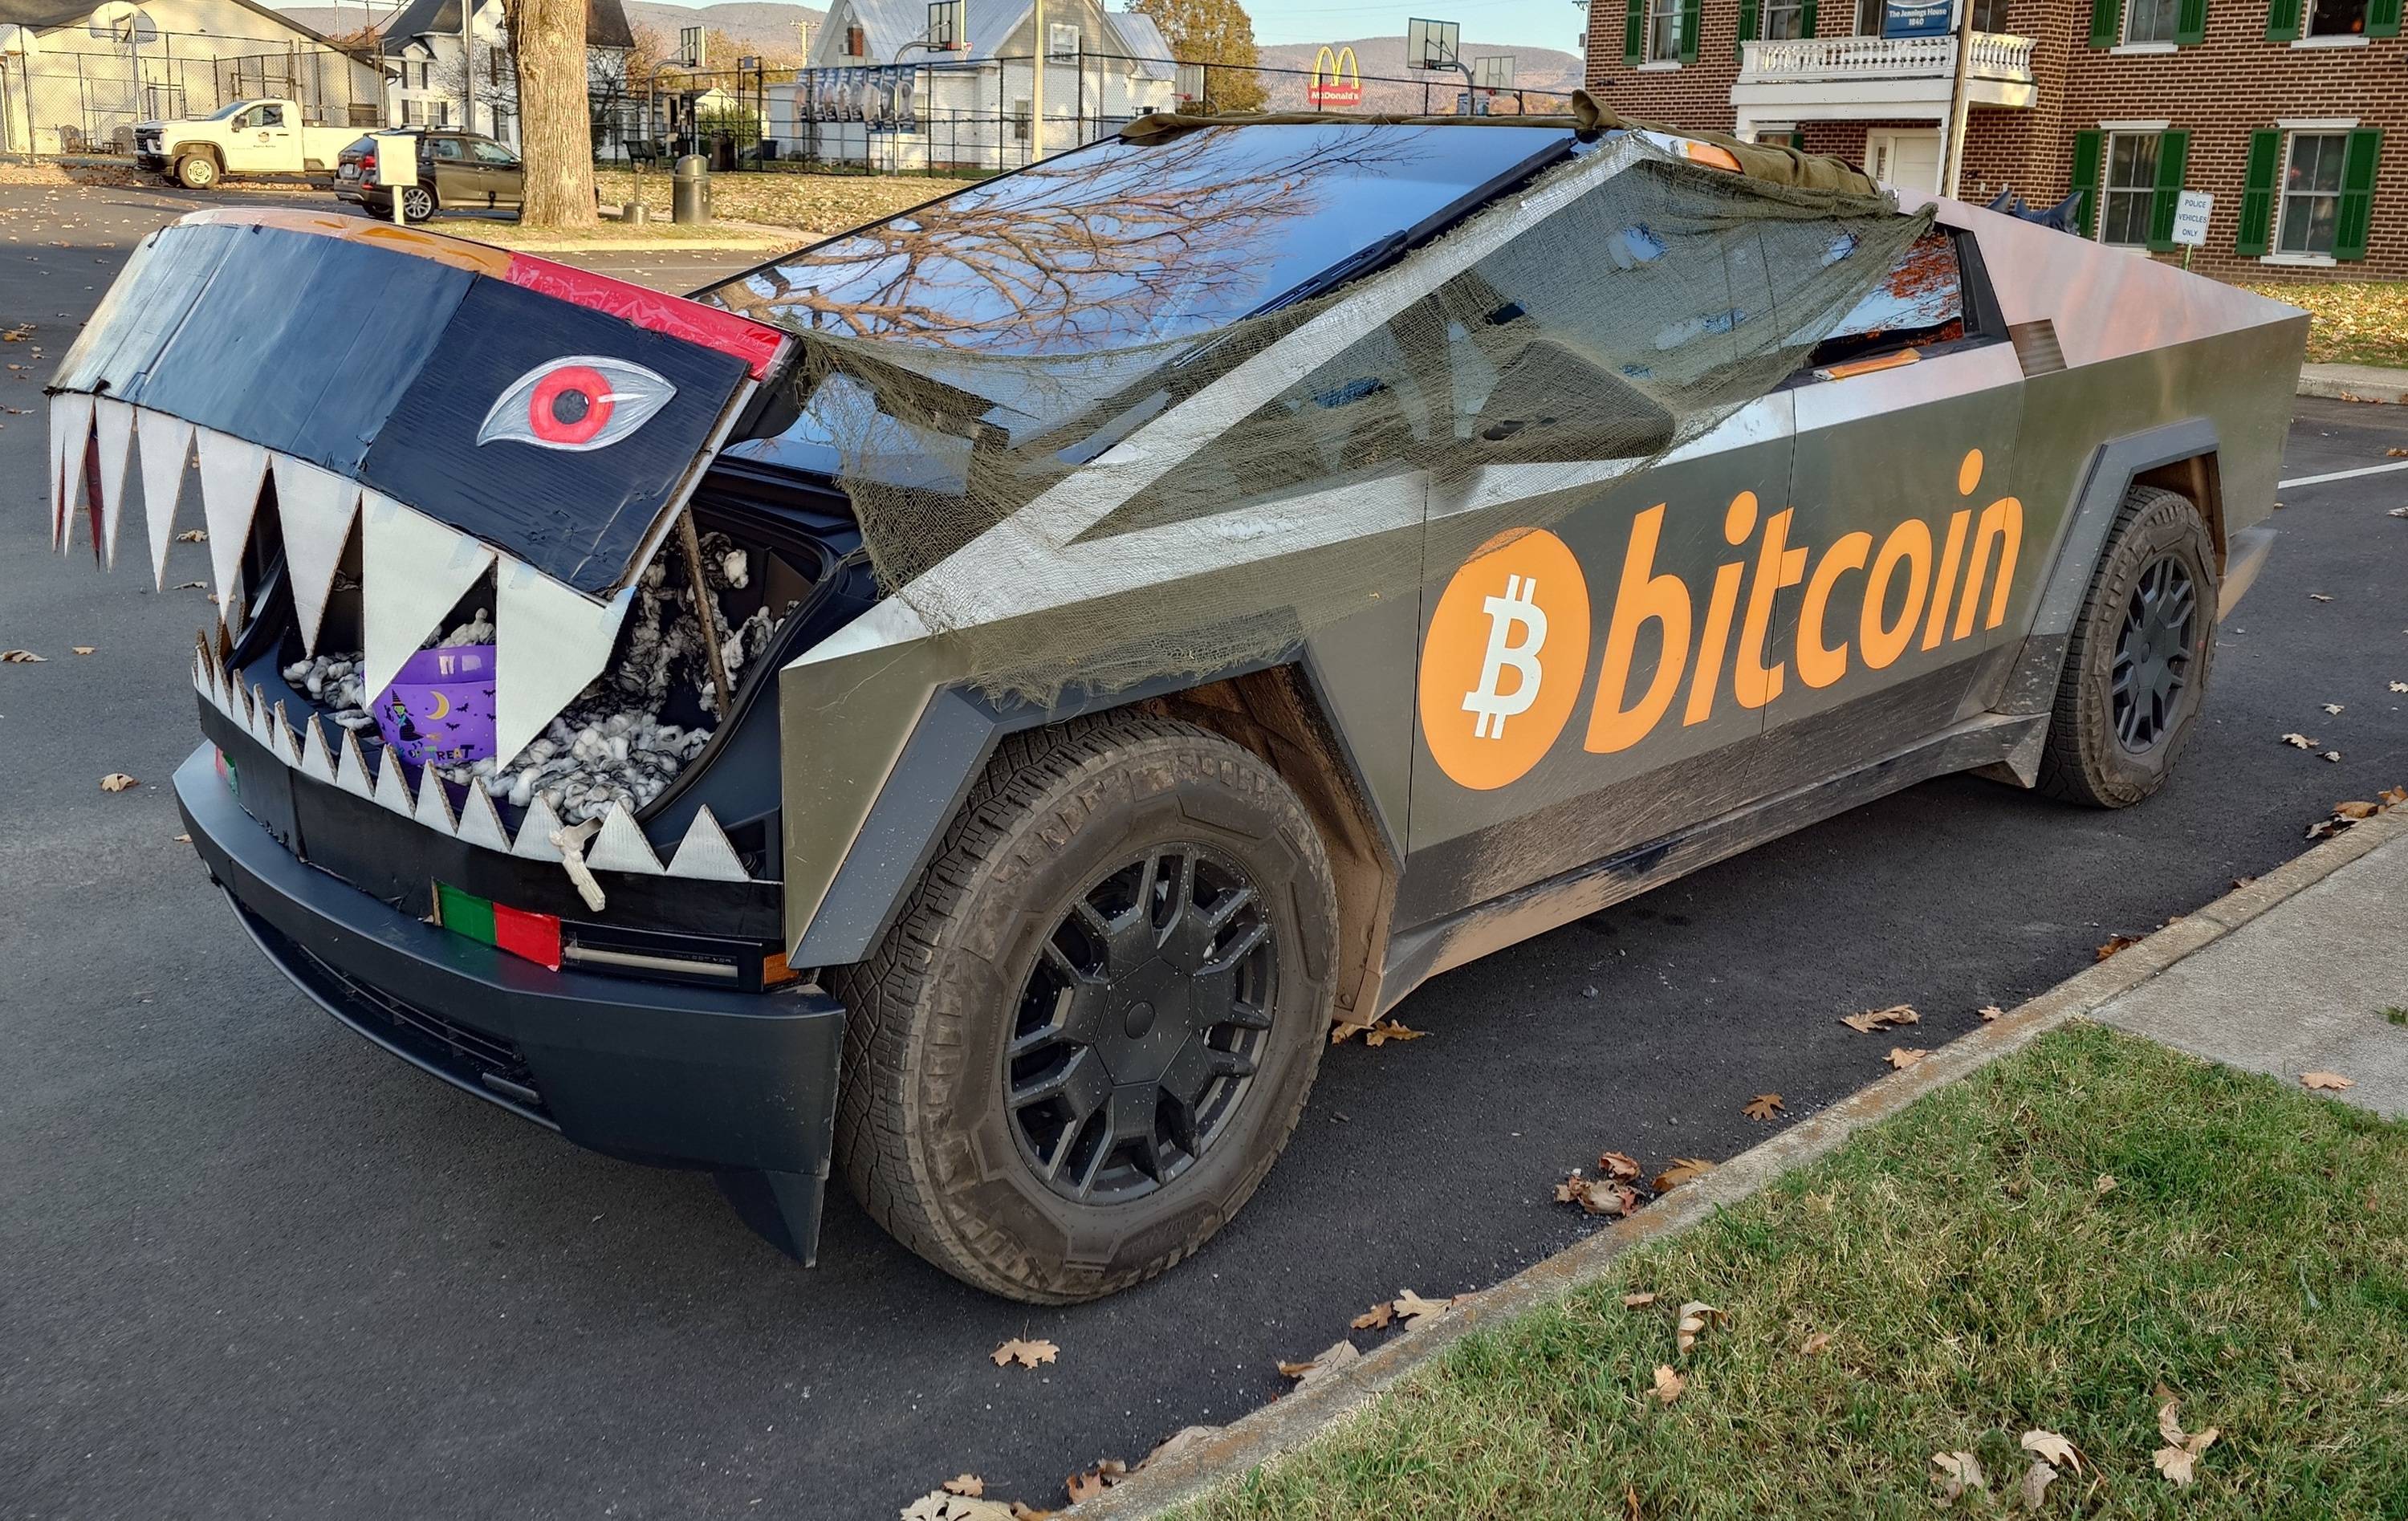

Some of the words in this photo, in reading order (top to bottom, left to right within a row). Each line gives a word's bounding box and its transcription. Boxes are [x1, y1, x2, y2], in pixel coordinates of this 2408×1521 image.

[1900, 9, 1927, 18] Jennings
[1908, 18, 1925, 26] 1840
[2184, 199, 2207, 208] POLICE
[2178, 214, 2207, 223] VEHICLES
[2182, 229, 2198, 237] ONLY
[1584, 449, 2024, 754] bitcoin
[424, 744, 475, 761] TREAT
